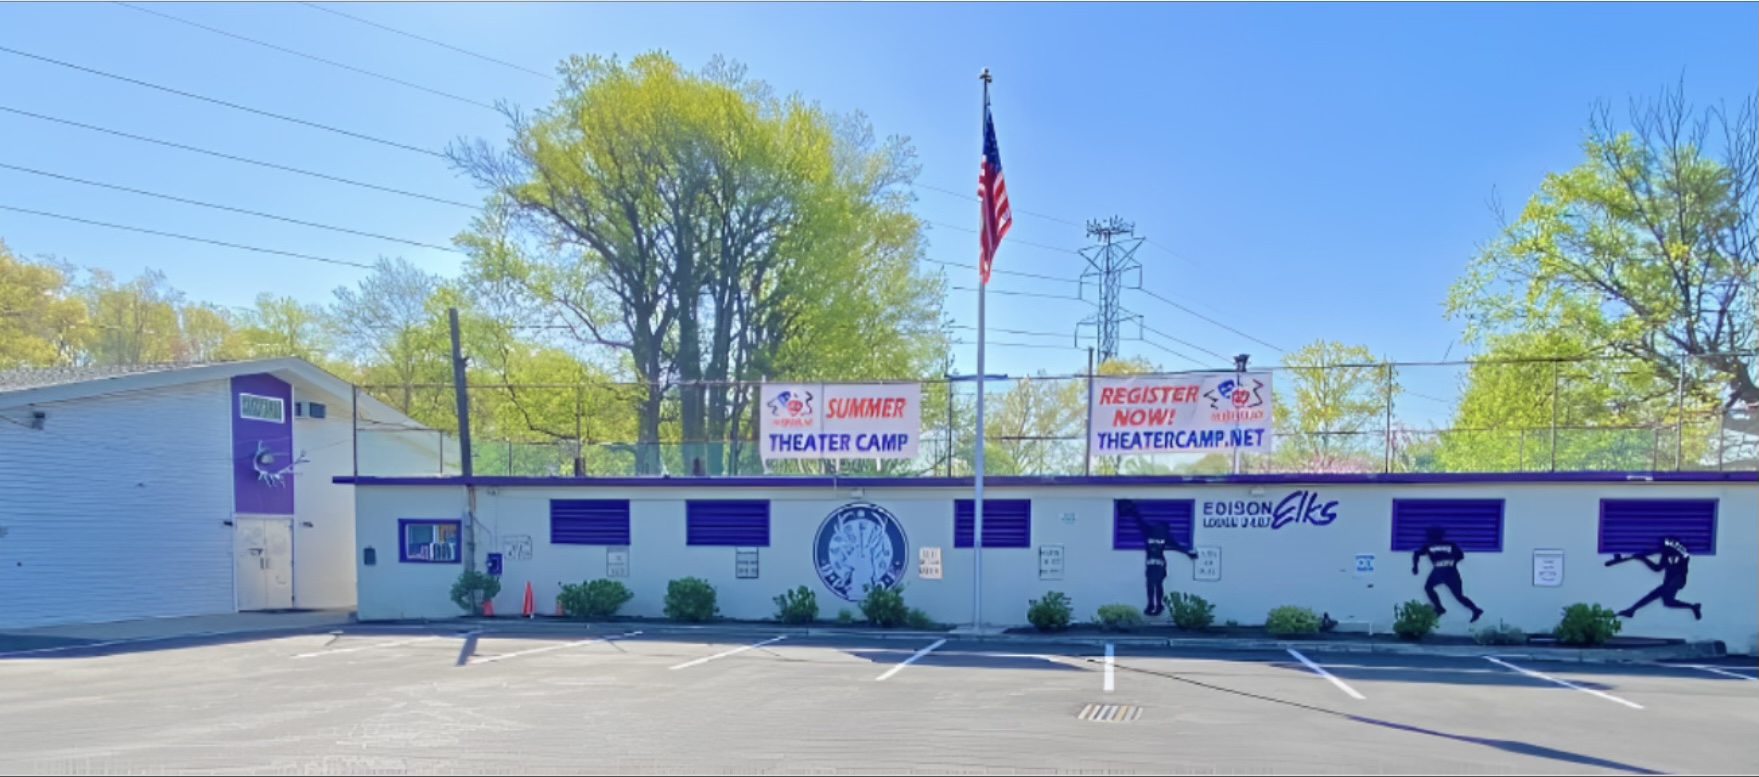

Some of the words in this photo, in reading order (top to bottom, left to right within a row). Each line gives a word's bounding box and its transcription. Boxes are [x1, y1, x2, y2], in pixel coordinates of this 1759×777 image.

[1100, 385, 1199, 405] REGISTER
[826, 397, 906, 419] SUMMER
[1113, 408, 1175, 427] NOW!
[769, 433, 851, 452] THEATER
[855, 433, 908, 452] CAMP
[1098, 428, 1265, 450] THEATERCAMP.NET
[1203, 501, 1273, 516] EDISON
[1271, 490, 1339, 530] Elks
